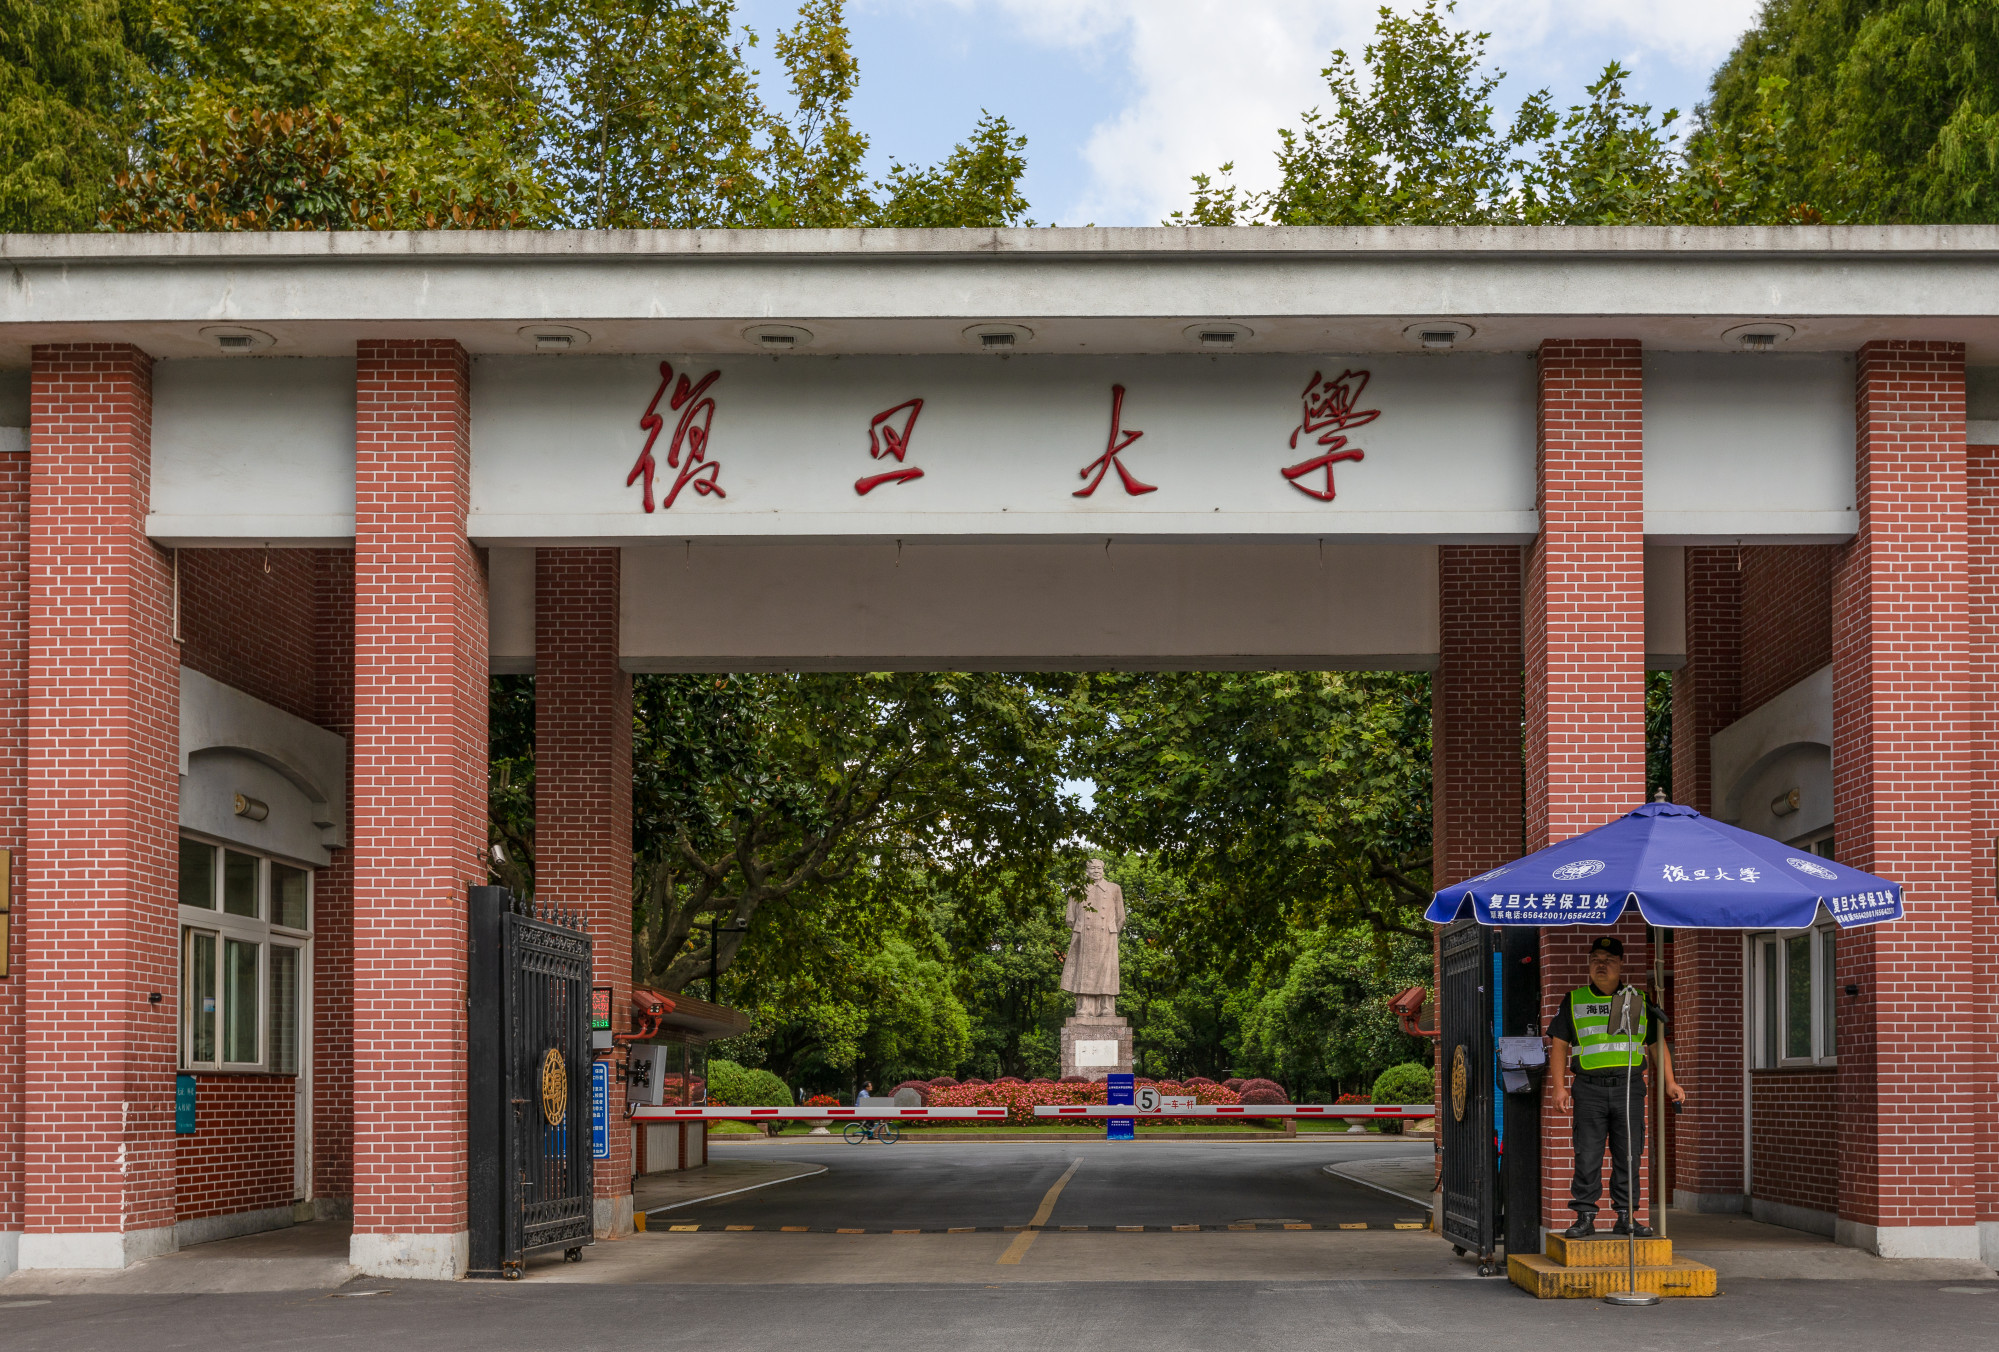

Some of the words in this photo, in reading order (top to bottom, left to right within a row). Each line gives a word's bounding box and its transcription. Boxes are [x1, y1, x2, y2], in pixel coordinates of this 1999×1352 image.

[1489, 893, 1609, 909] 复旦大学保卫处
[1832, 889, 1895, 913] 复旦大学保卫处
[1586, 1004, 1610, 1015] 海阳
[1142, 1091, 1153, 1109] 5
[1164, 1100, 1194, 1109] 一车一杆
